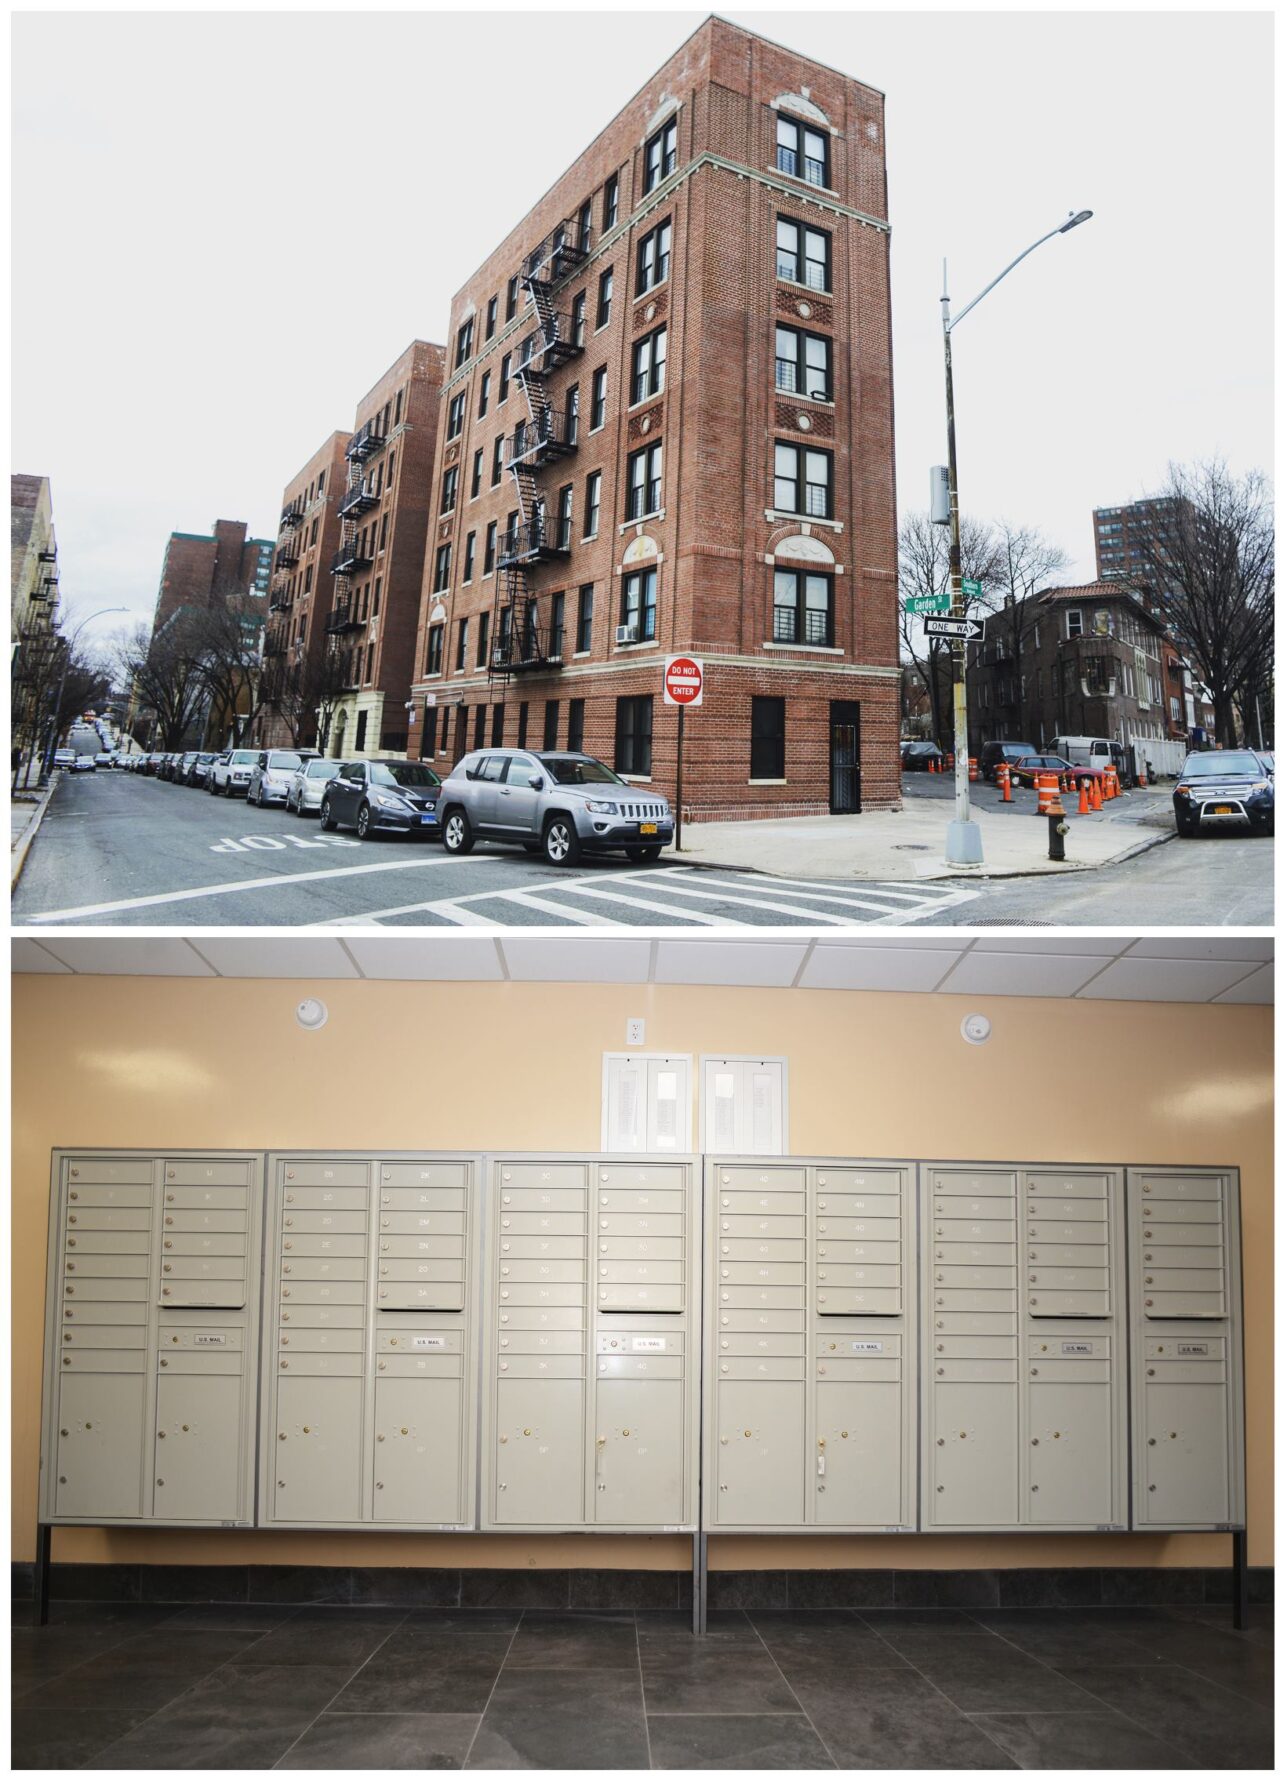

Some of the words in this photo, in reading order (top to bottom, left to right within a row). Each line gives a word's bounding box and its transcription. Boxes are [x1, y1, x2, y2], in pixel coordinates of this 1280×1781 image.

[914, 599, 936, 610] Garden
[932, 622, 949, 631] ONE
[957, 624, 974, 633] WAY
[672, 666, 681, 674] DO
[683, 667, 696, 675] NOT
[673, 687, 694, 695] ENTER
[209, 834, 362, 852] STOP
